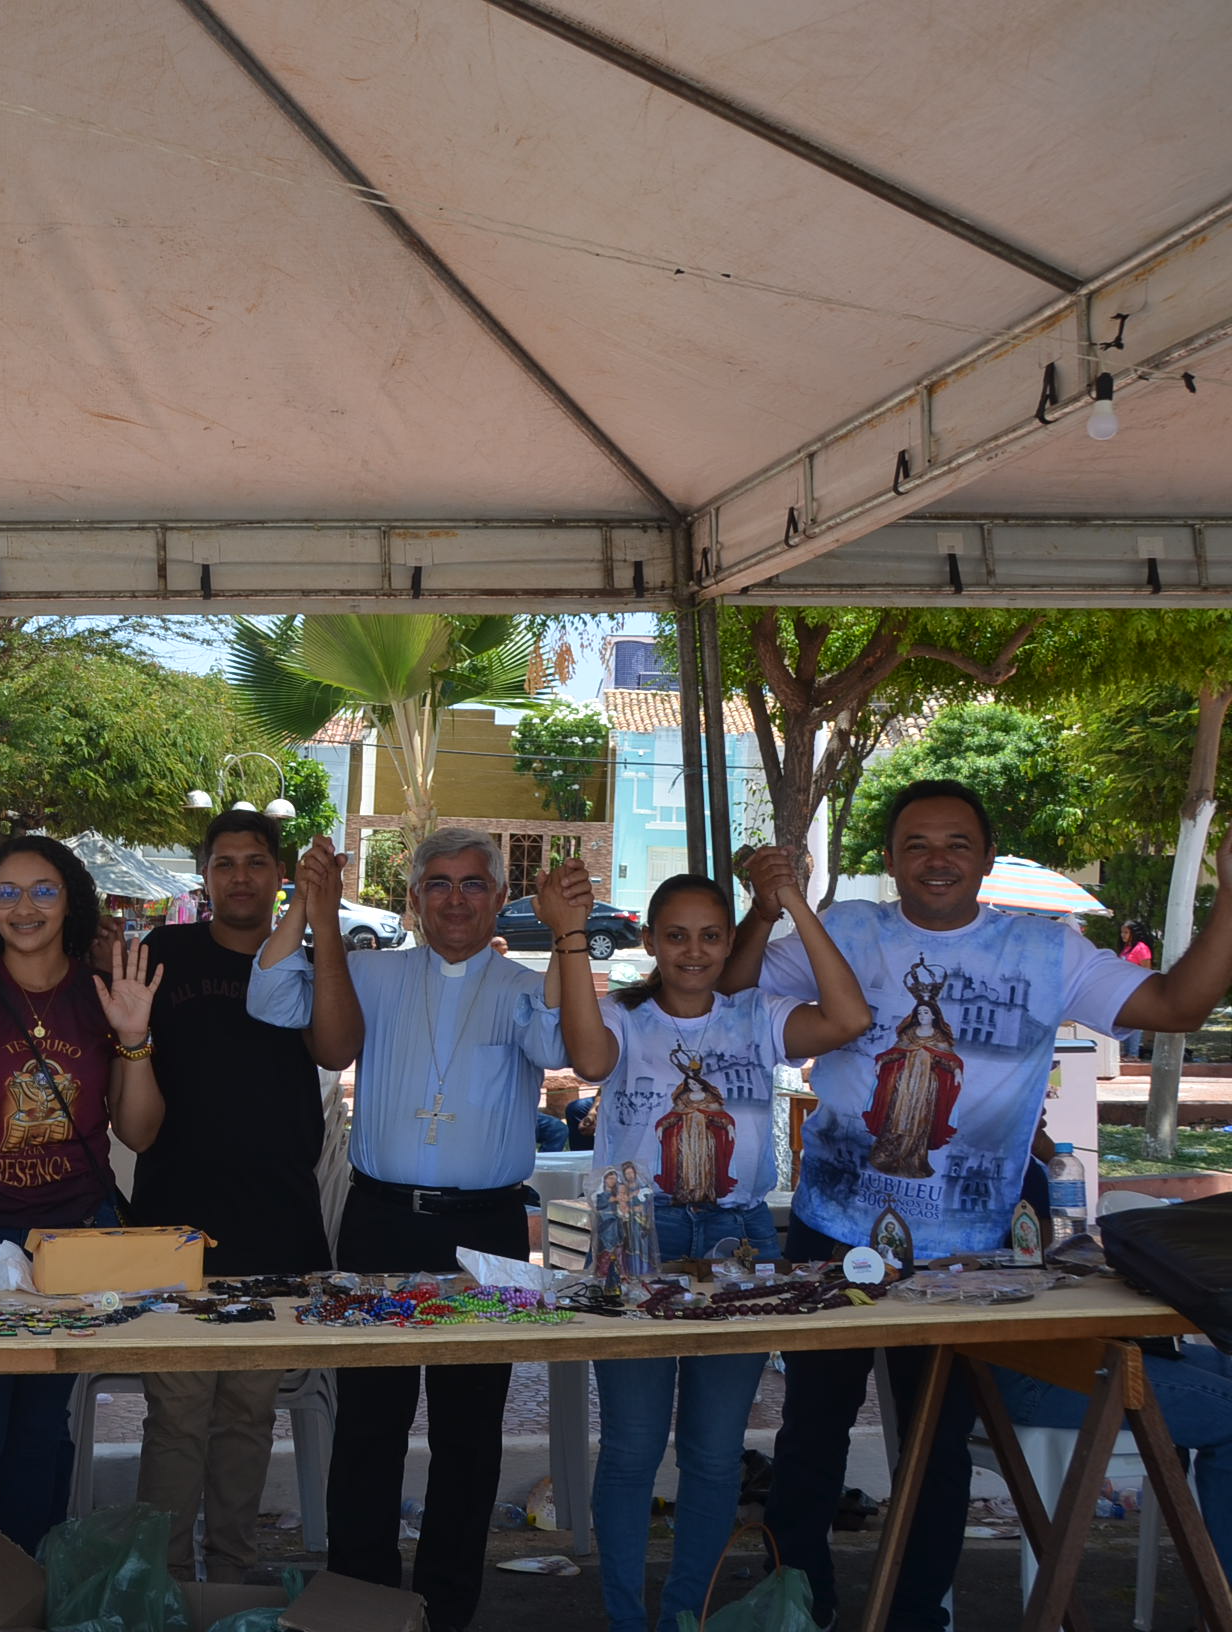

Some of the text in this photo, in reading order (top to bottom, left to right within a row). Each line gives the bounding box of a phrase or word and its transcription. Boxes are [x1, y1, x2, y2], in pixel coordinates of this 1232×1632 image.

[859, 1172, 943, 1202] JUBILEU
[894, 1198, 921, 1209] NOS
[925, 1202, 941, 1213] DE
